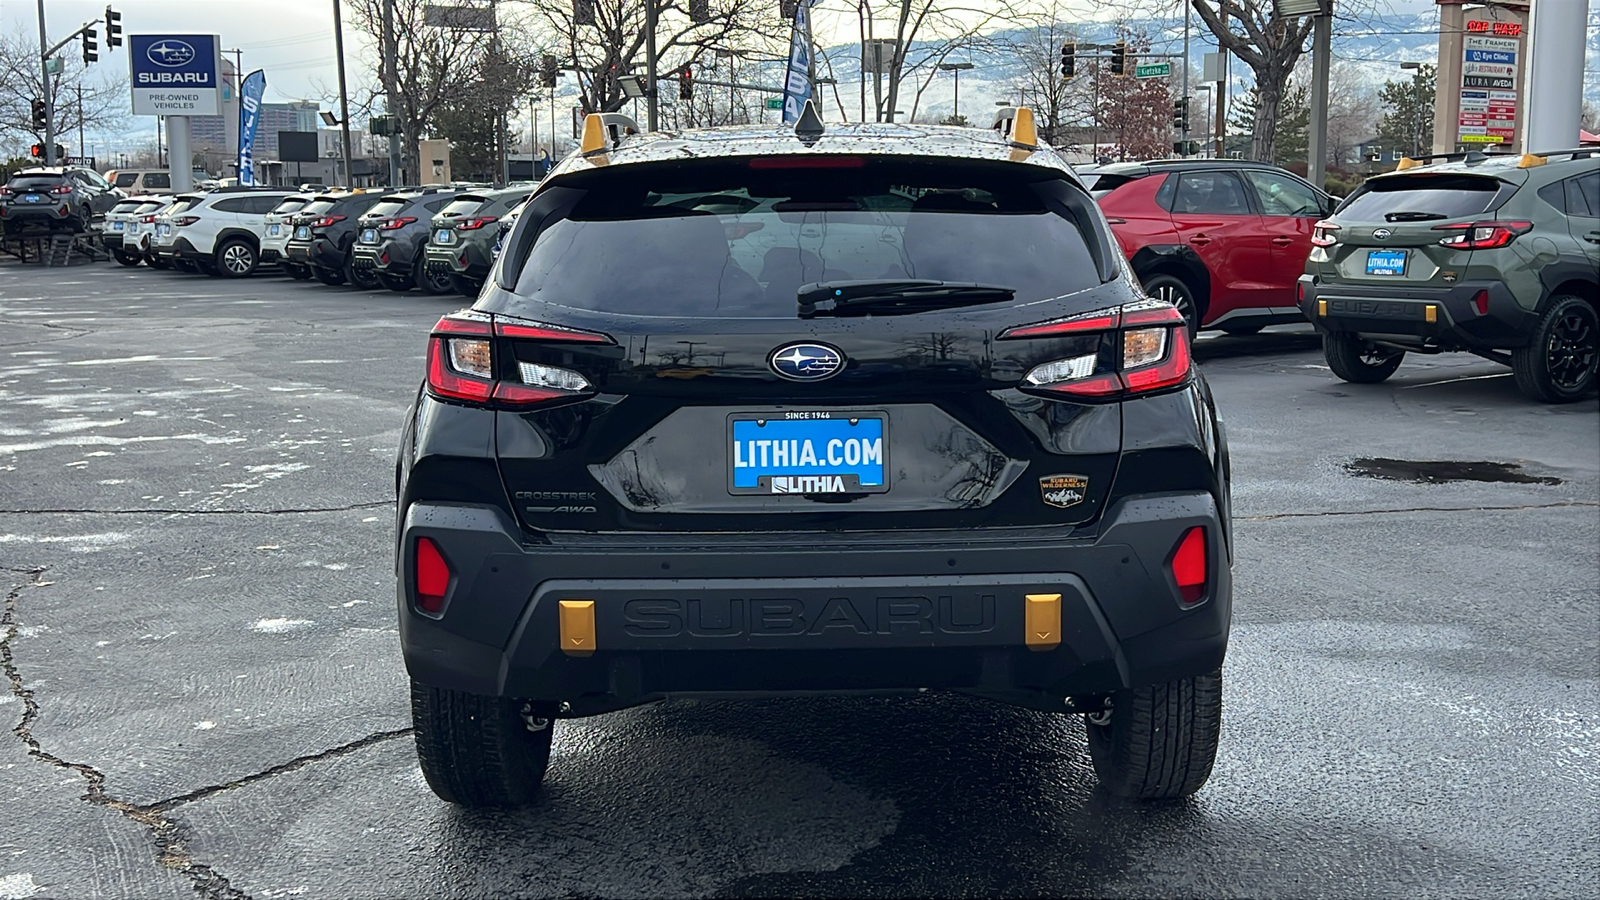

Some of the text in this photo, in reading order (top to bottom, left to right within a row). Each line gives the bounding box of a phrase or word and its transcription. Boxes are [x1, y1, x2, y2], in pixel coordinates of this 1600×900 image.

[1468, 21, 1521, 35] CAR WASH
[1485, 39, 1516, 47] FRAMERY
[1482, 52, 1509, 61] Eye Clinic
[1141, 66, 1161, 76] Kietzke
[1478, 66, 1506, 74] RESTAURANT
[138, 72, 208, 83] SUBARU
[1465, 78, 1513, 88] AURA AVEDA
[1368, 258, 1404, 268] LITHIA.COM
[1331, 301, 1418, 317] SUBARU
[785, 412, 810, 420] SINCE
[734, 438, 882, 468] LITHIA.COM
[788, 476, 846, 493] LITHIA
[515, 491, 597, 500] CROSSTREK
[623, 594, 997, 638] SUBARU
